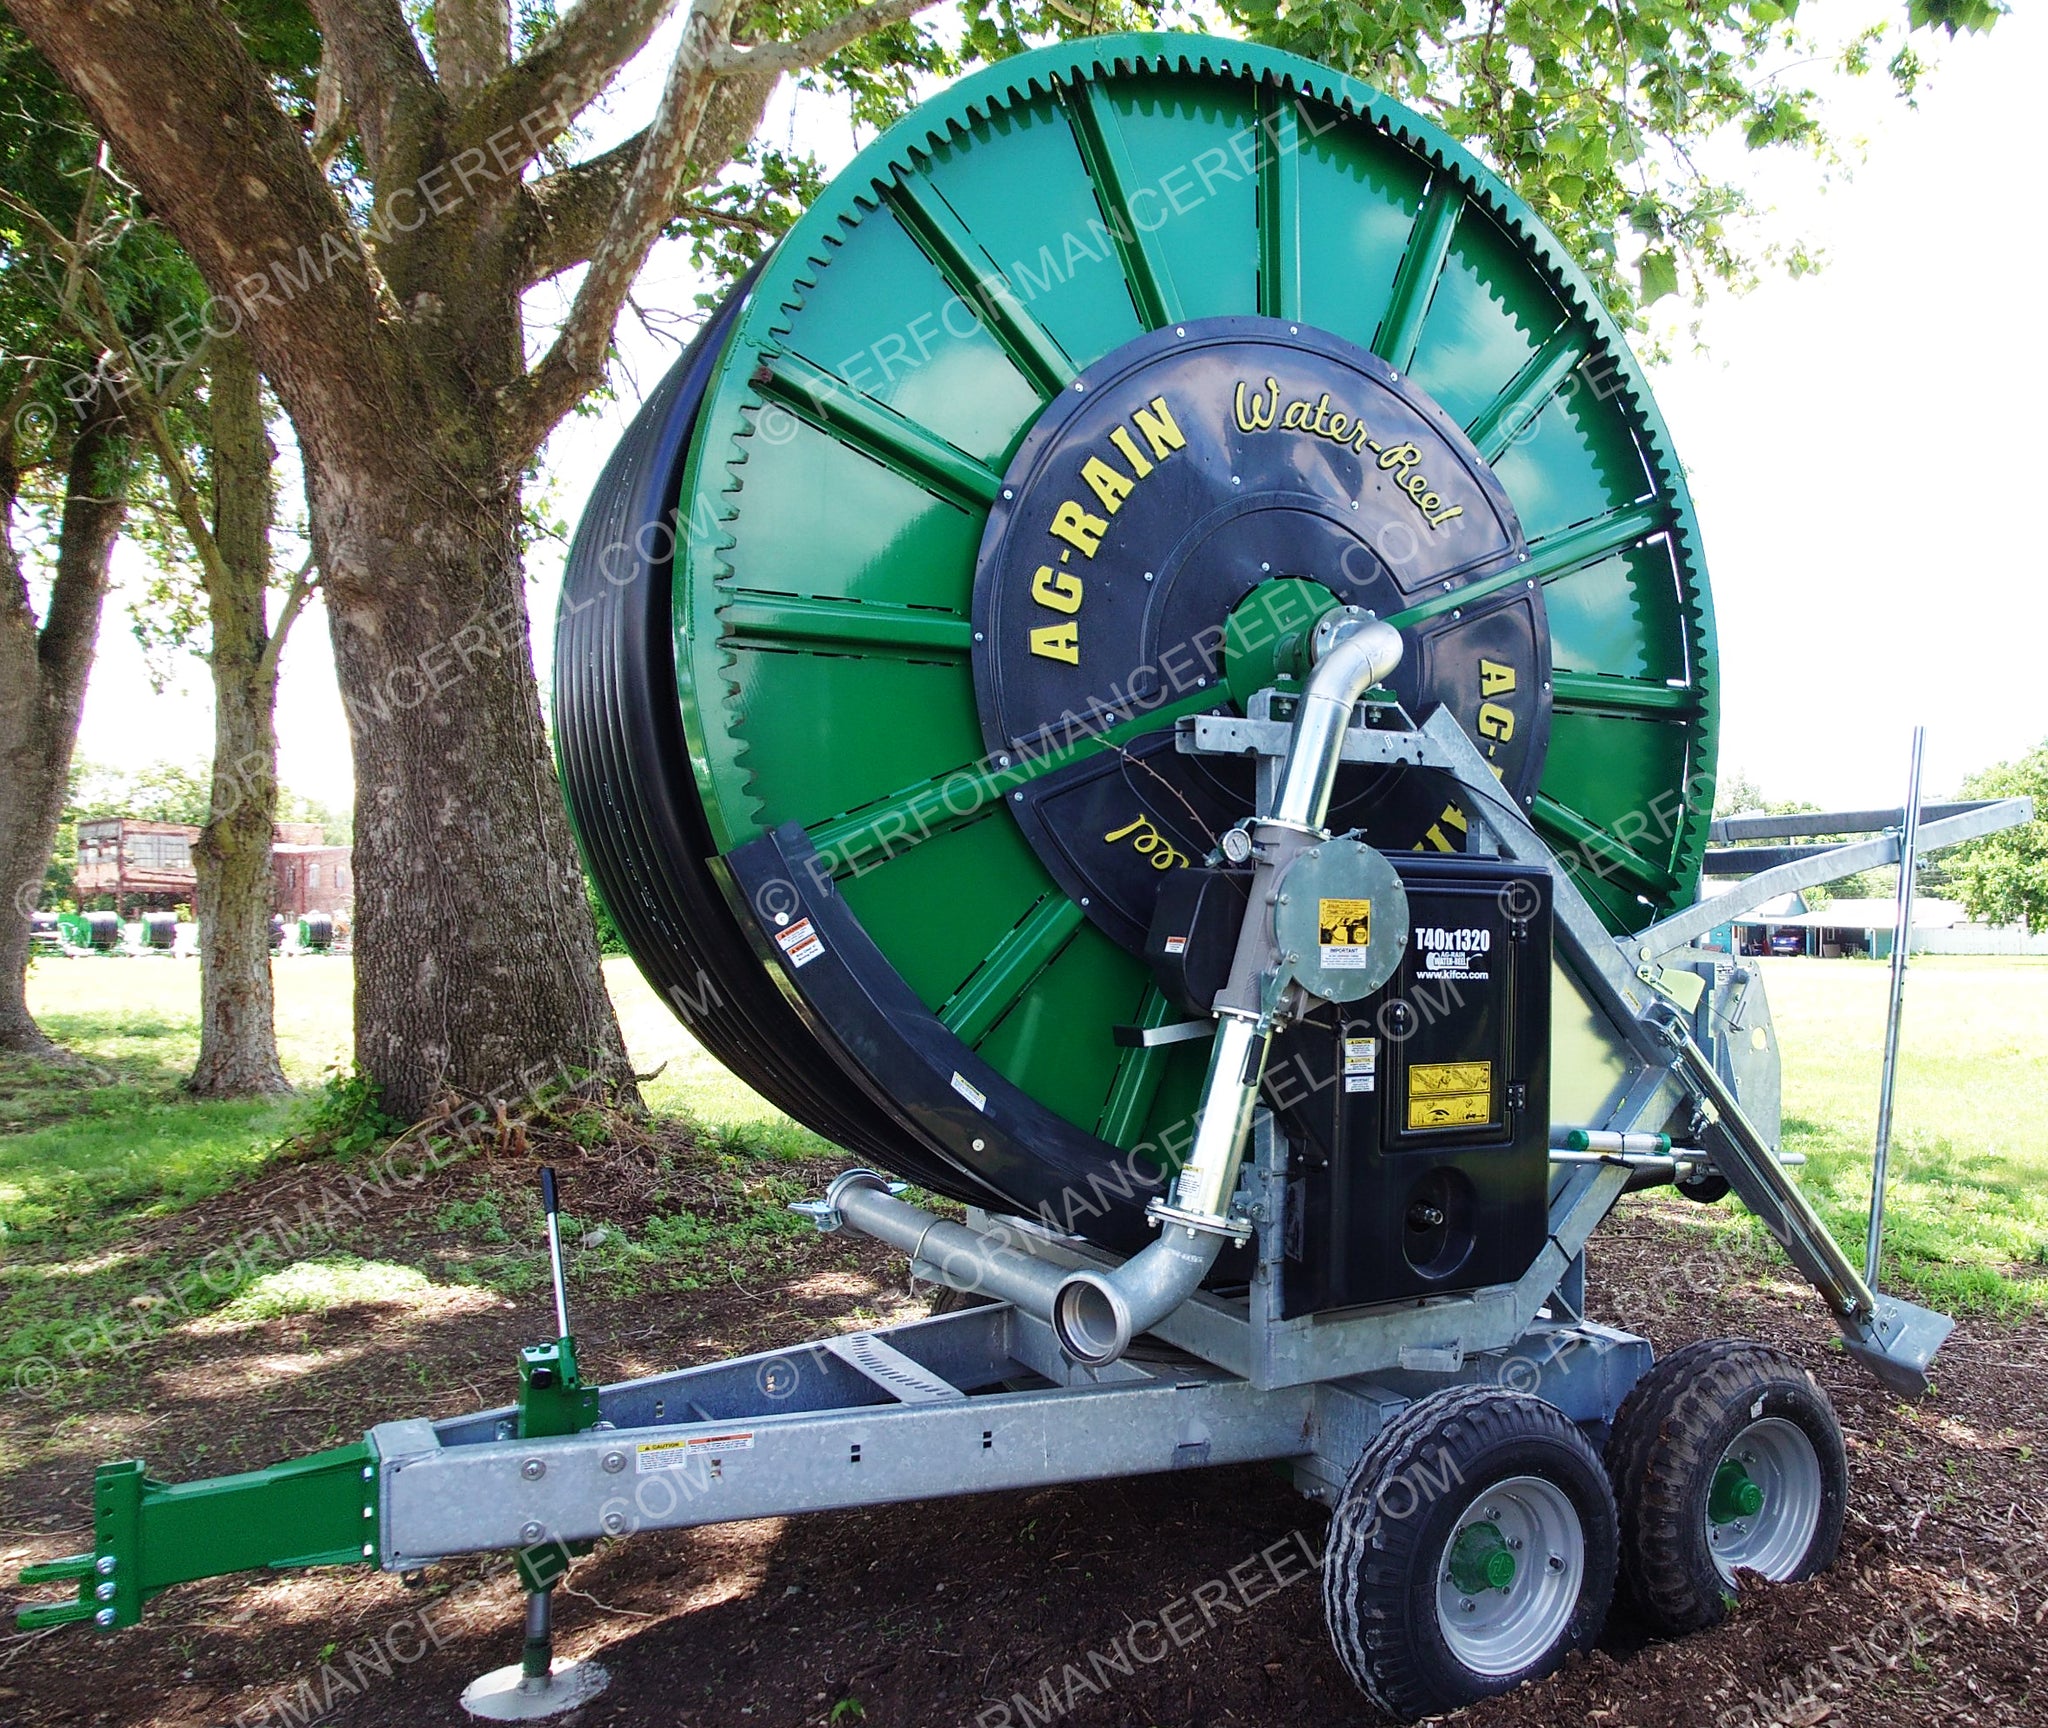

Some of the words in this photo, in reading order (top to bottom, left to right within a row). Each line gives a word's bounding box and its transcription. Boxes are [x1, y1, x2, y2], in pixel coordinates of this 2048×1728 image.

[1234, 377, 1464, 531] Water-Reel
[1030, 396, 1189, 666] AG-RAIN
[1415, 928, 1490, 951] T40x1320
[1416, 970, 1489, 980] www.kifco.com
